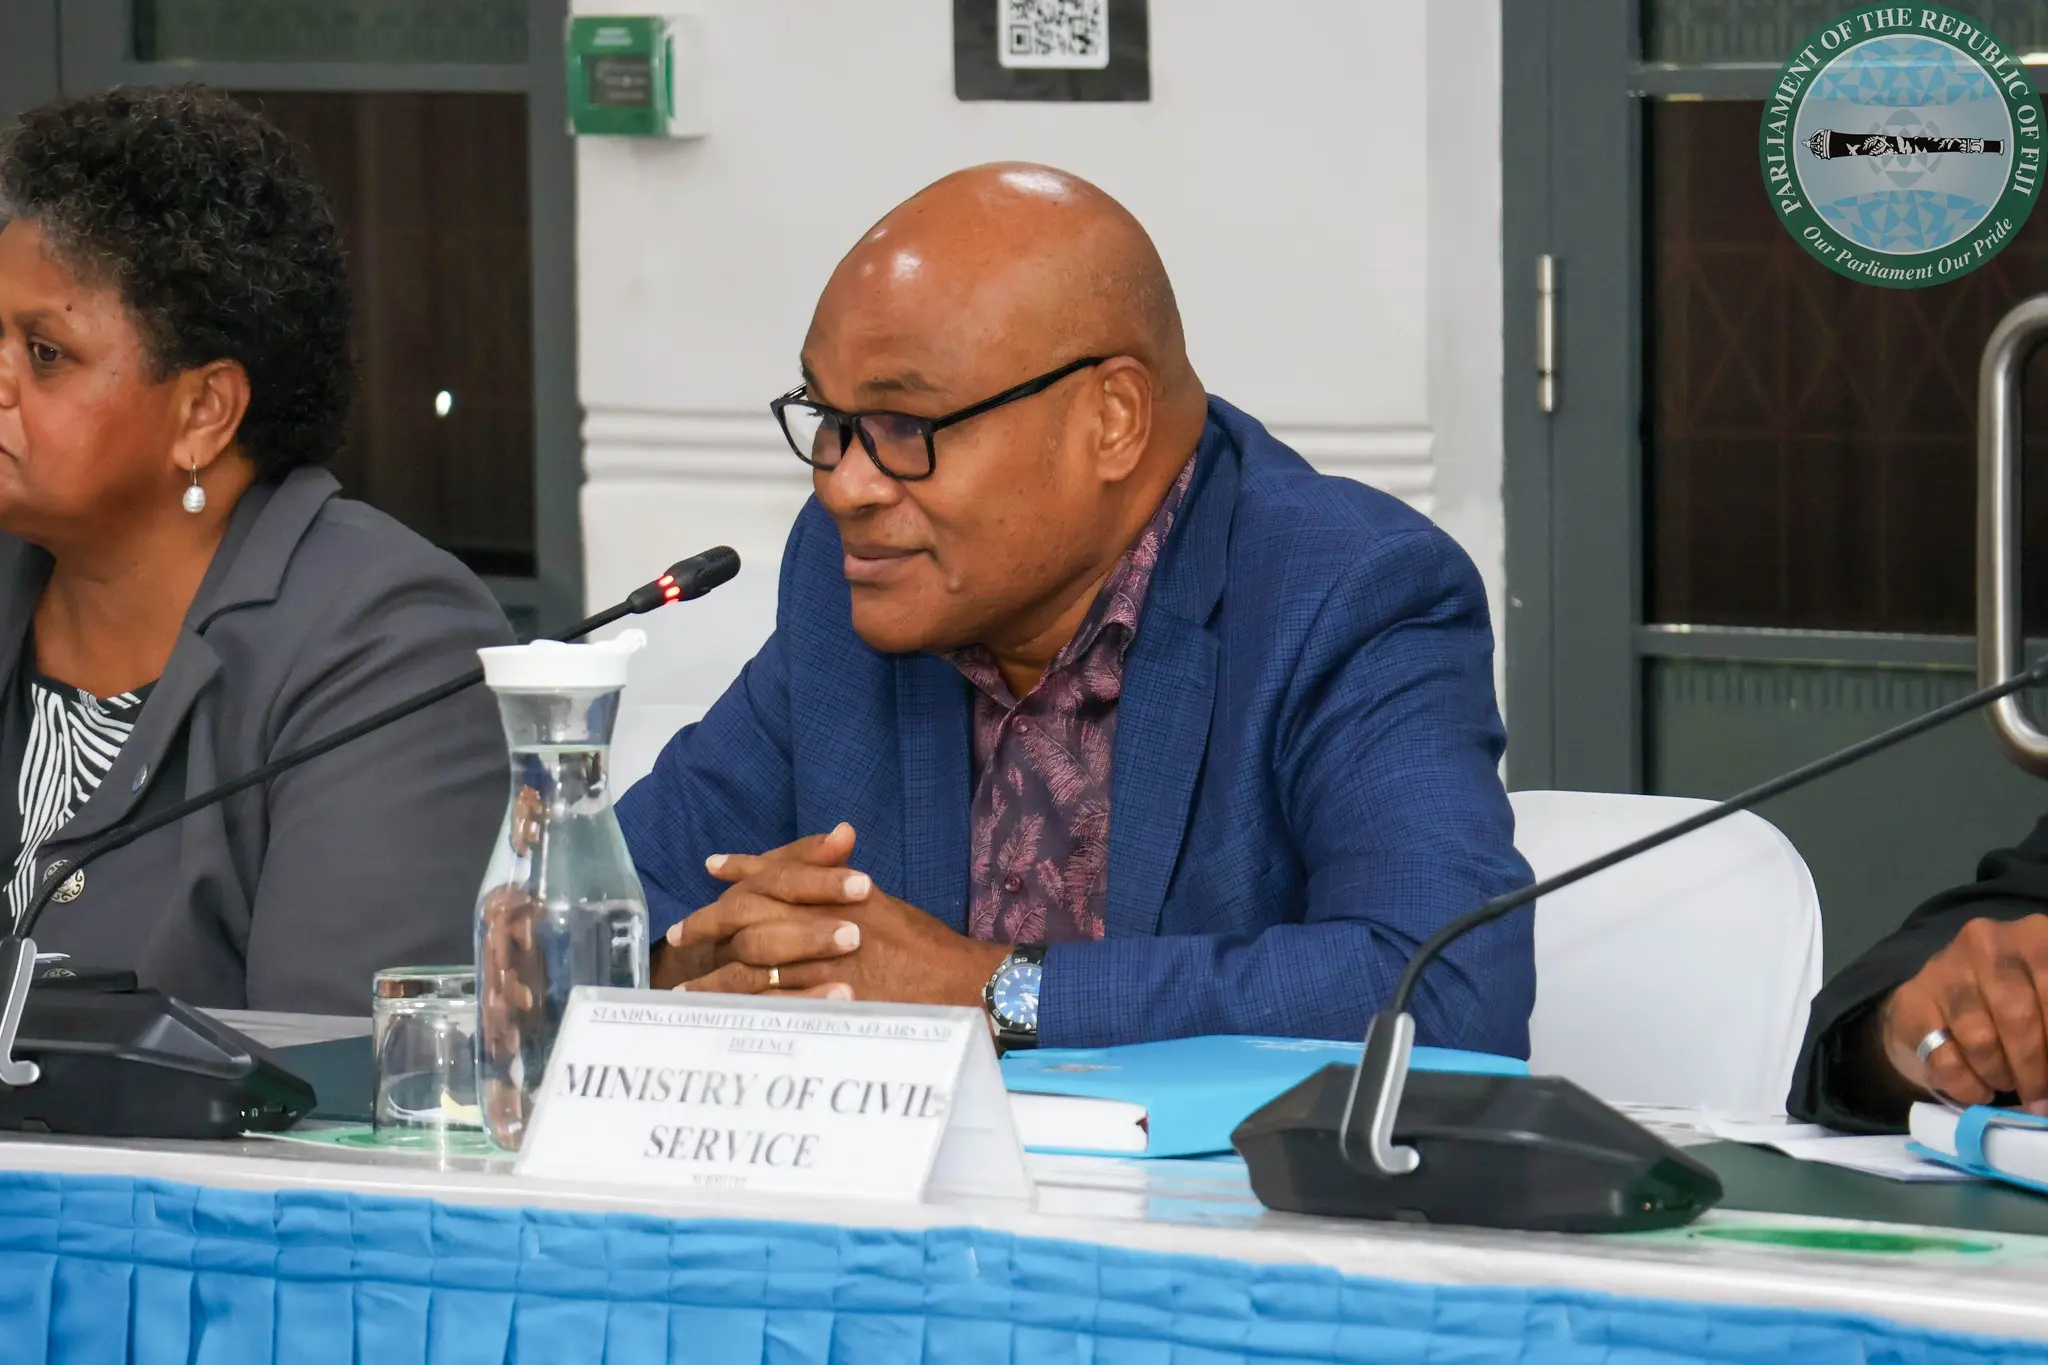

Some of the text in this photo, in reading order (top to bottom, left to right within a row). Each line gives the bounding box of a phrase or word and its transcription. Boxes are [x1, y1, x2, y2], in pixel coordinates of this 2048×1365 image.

[557, 1063, 945, 1119] MINISTRY OF CIVIL
[644, 1124, 821, 1169] SERVICE
